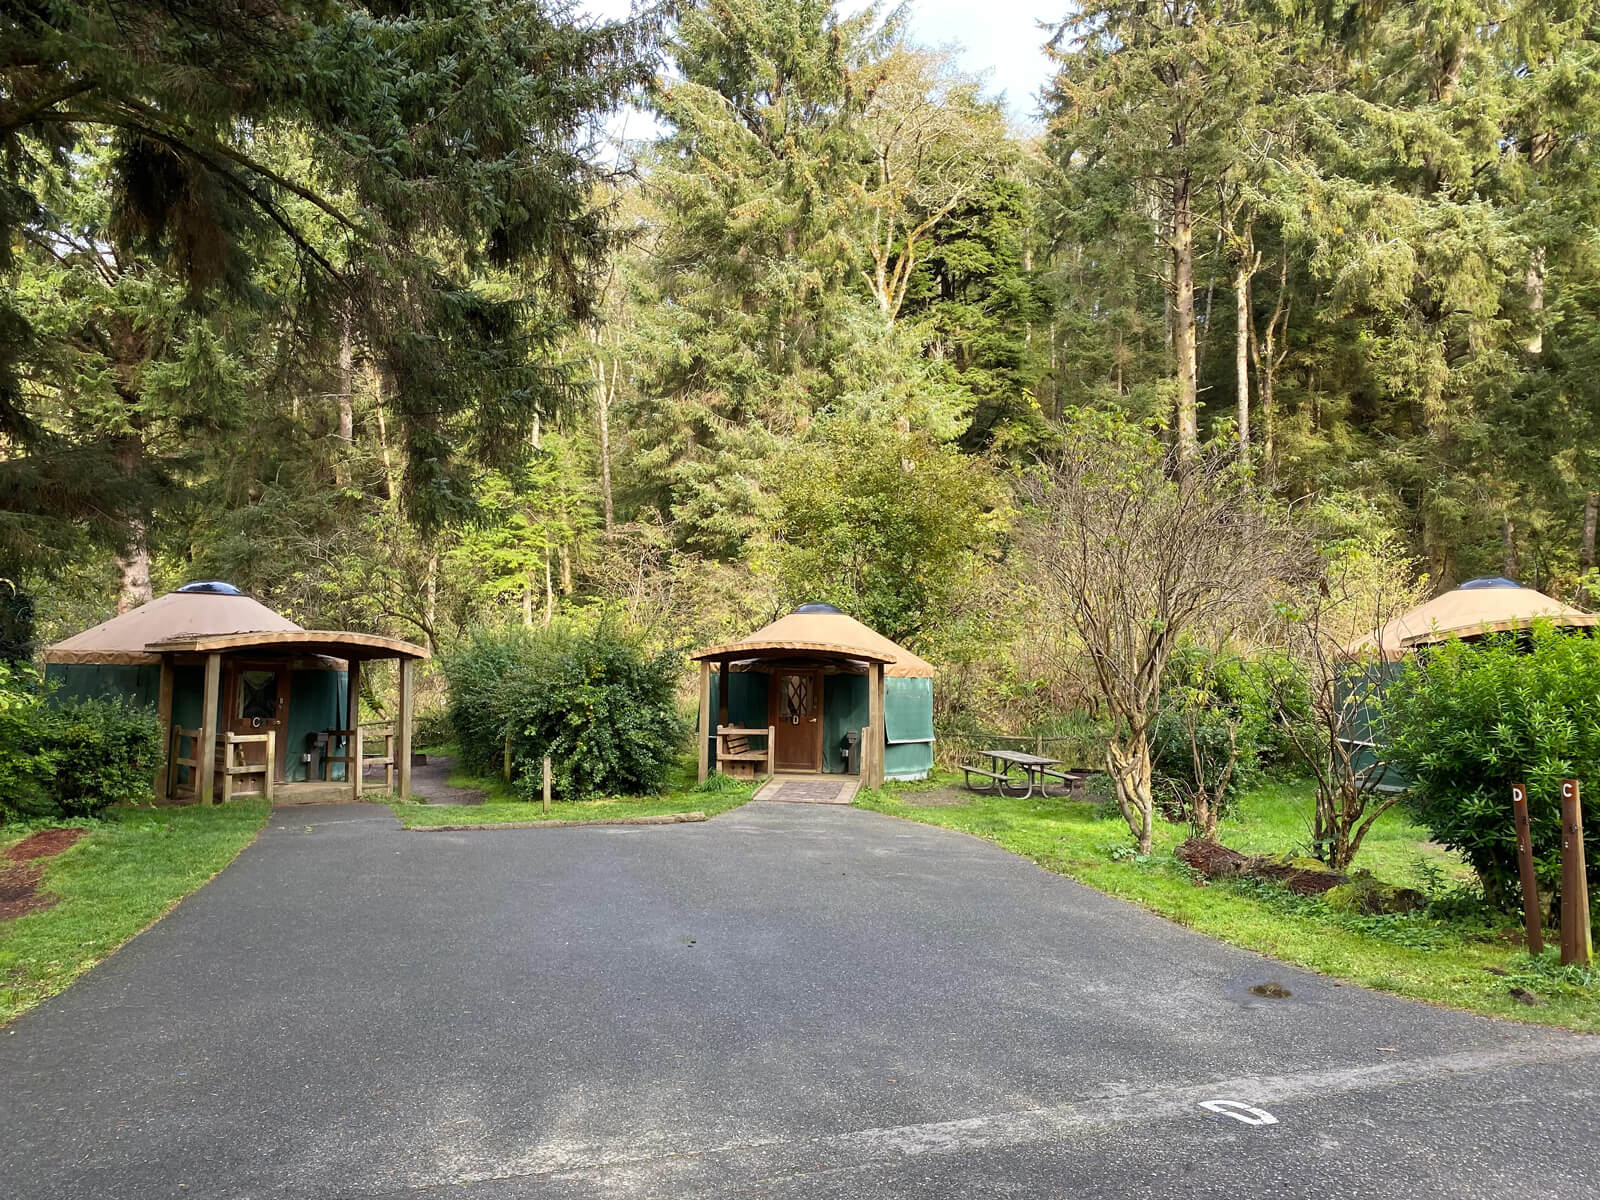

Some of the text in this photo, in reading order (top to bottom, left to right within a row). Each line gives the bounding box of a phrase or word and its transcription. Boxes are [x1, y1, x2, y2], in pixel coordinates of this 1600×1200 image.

[253, 717, 261, 728] C
[1512, 788, 1523, 802] D
[1563, 783, 1573, 797] C
